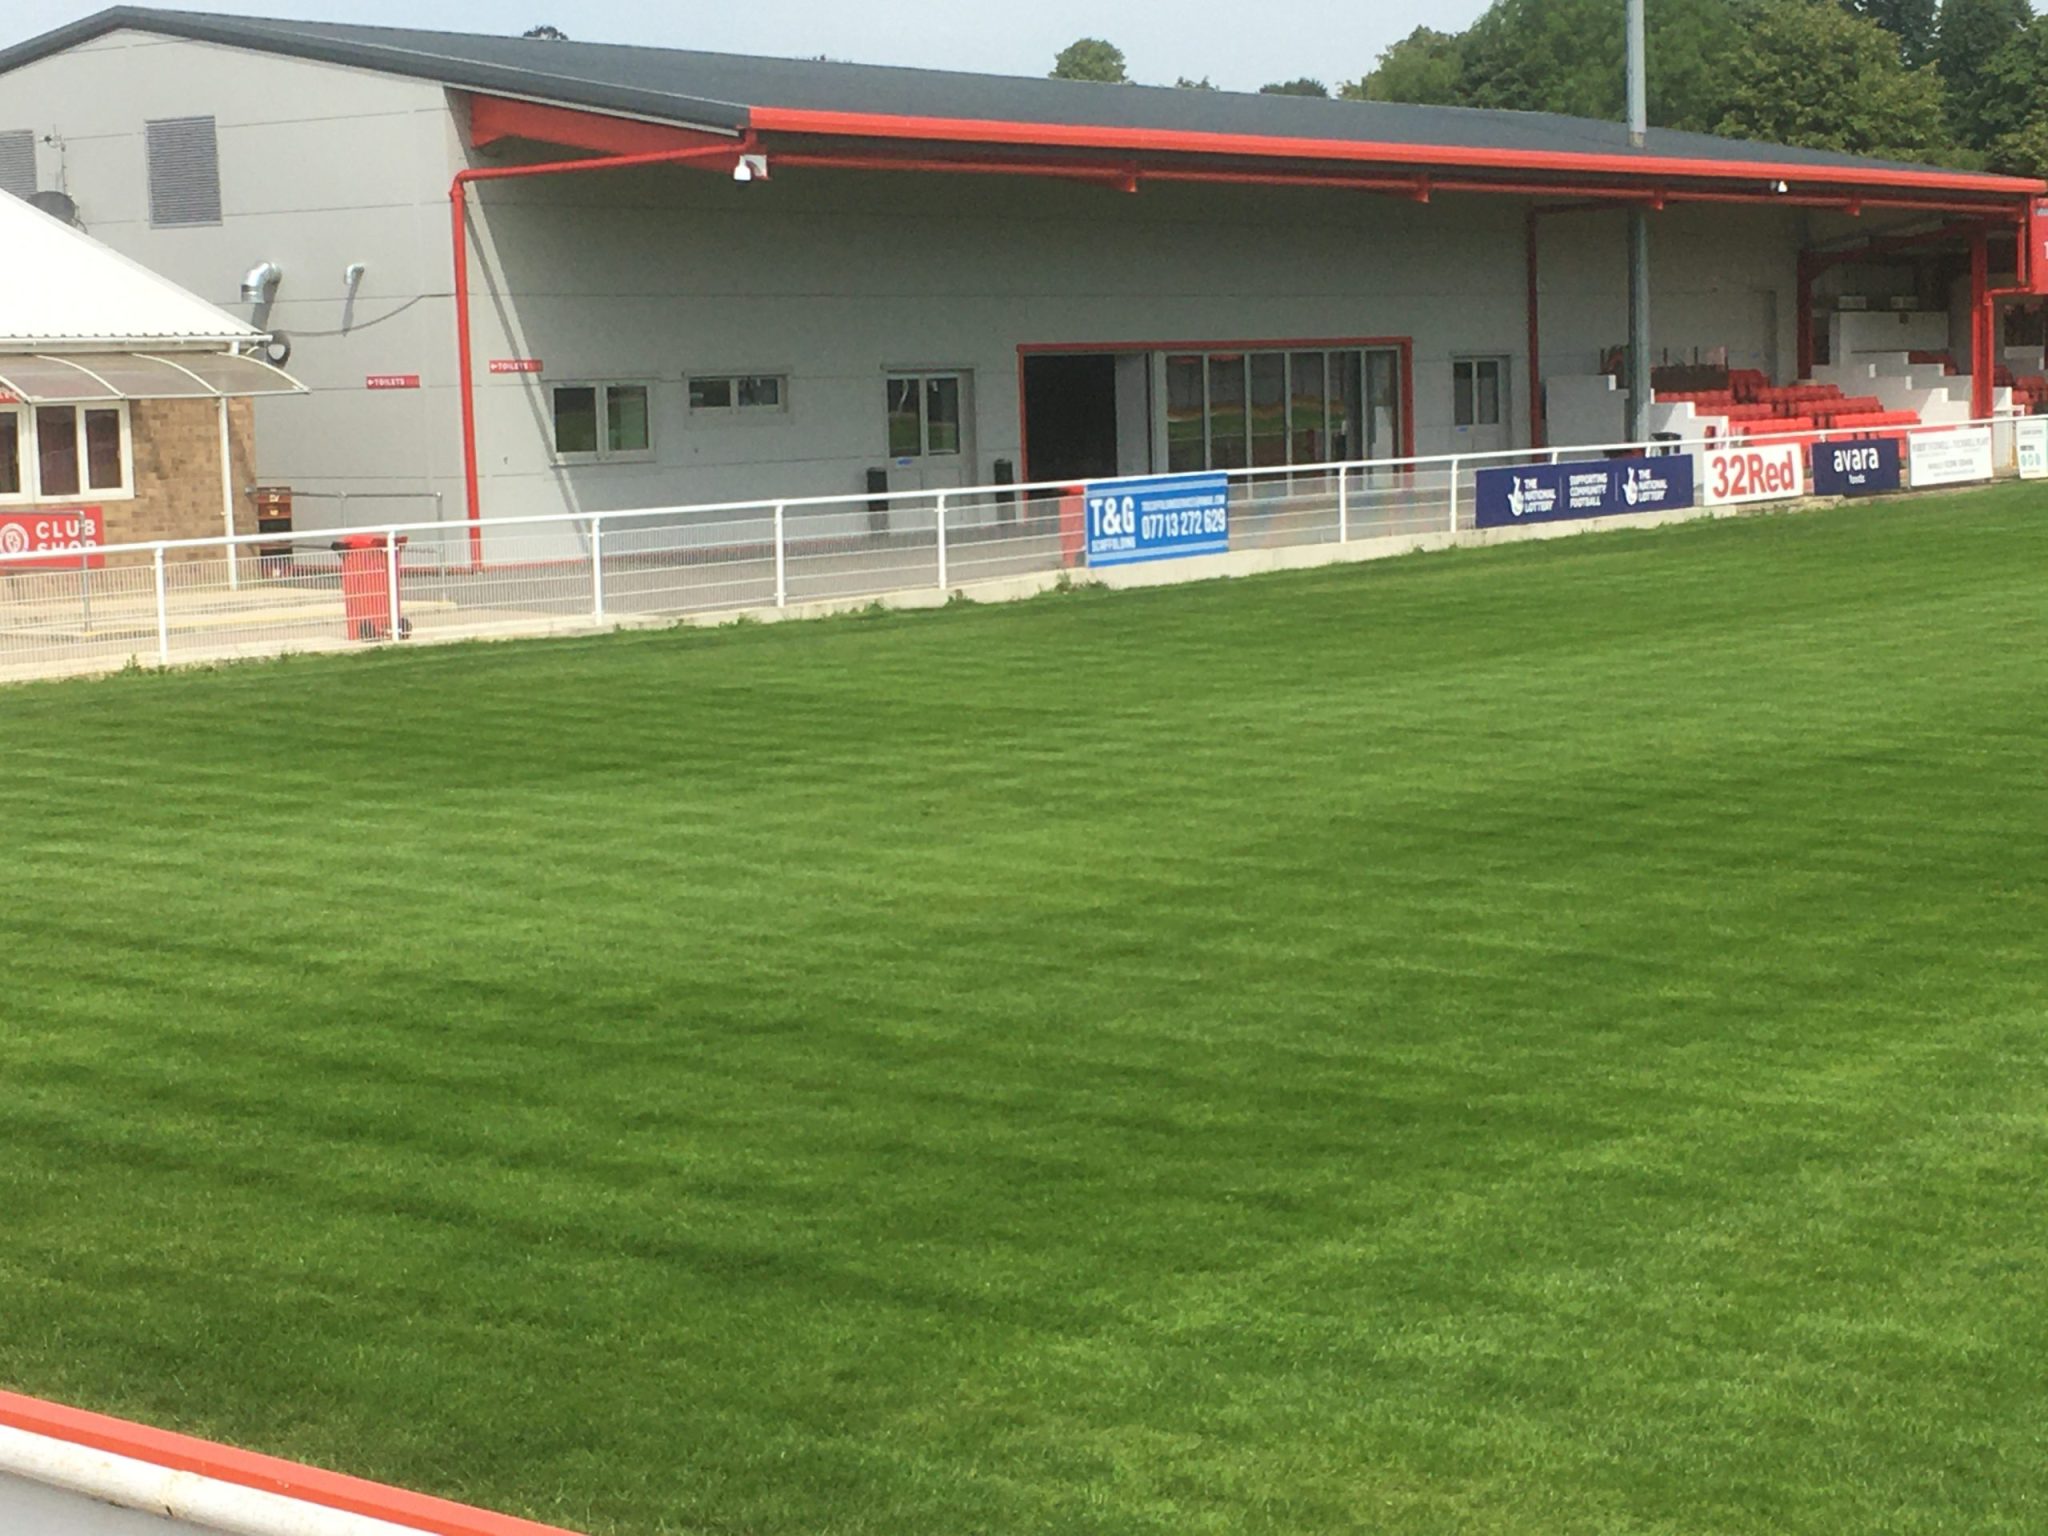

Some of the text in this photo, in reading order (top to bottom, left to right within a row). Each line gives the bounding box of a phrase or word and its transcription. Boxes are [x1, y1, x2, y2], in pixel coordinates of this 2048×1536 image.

[498, 362, 529, 371] TOILETS
[373, 378, 405, 386] TOILETS
[1833, 448, 1880, 472] avara
[1569, 473, 1607, 485] SUPPORTING
[1637, 469, 1651, 480] THE
[1712, 451, 1795, 498] 32Red
[1524, 478, 1538, 489] THE
[1638, 480, 1667, 491] NATIONAL
[1525, 489, 1555, 500] NATIONAL
[1569, 485, 1606, 496] COMMUNITY
[1638, 491, 1665, 502] LOTTERY
[1525, 501, 1553, 512] LOTTERY
[1569, 497, 1600, 508] FOOTBALL
[1090, 496, 1135, 537] T&G
[1180, 509, 1202, 536] 272
[1203, 507, 1226, 533] 629
[35, 519, 96, 539] CLUB
